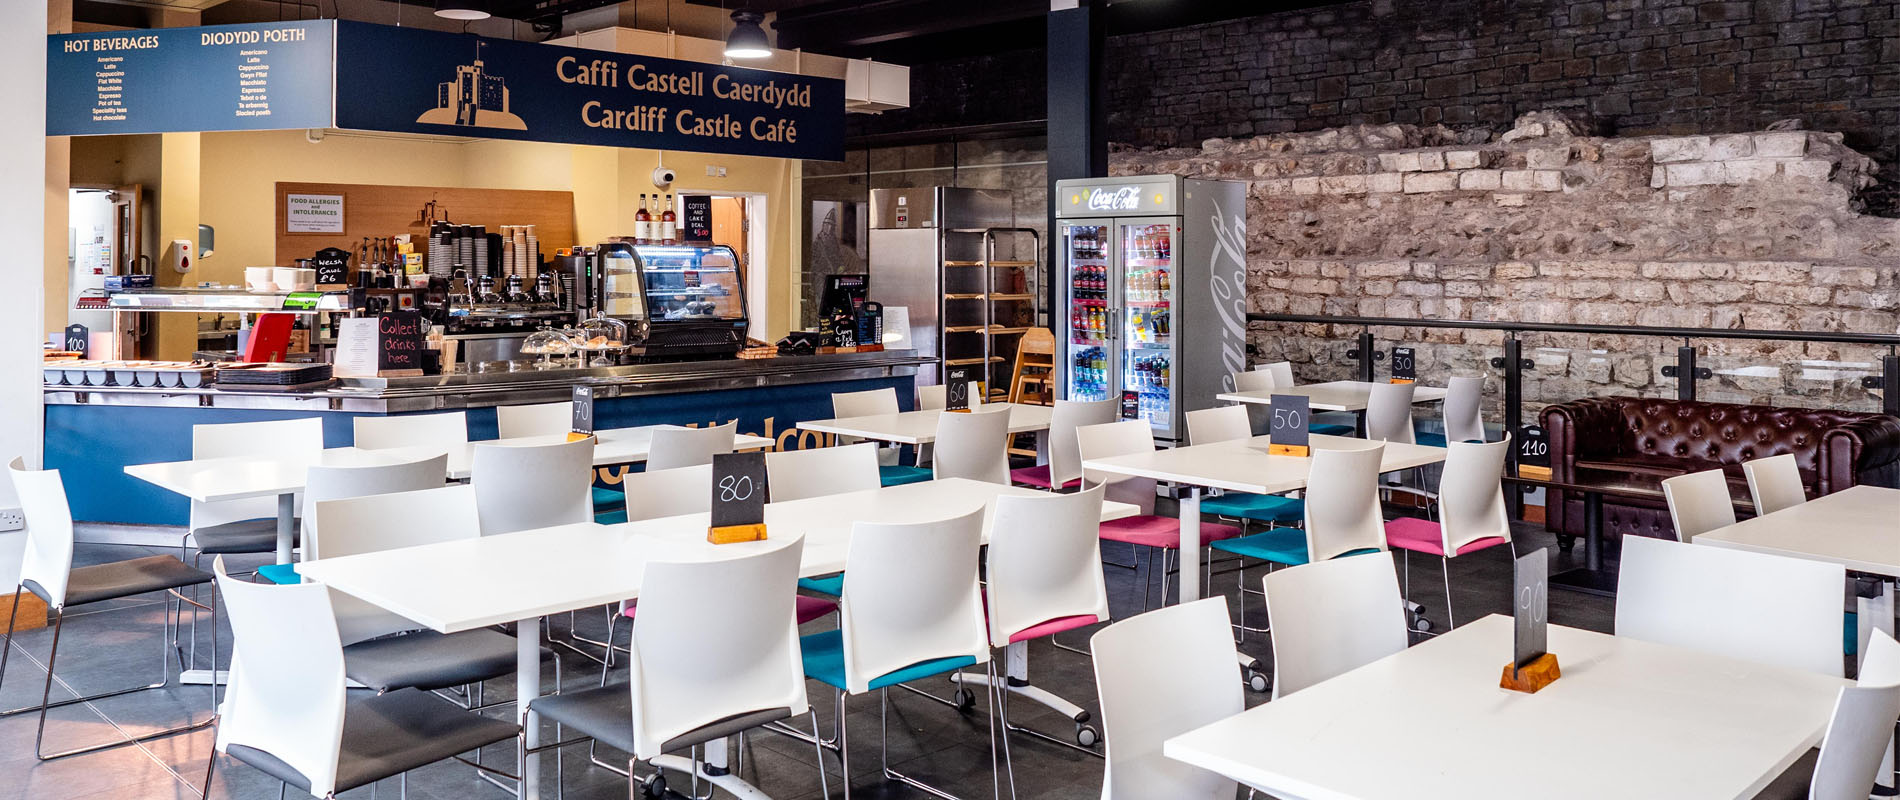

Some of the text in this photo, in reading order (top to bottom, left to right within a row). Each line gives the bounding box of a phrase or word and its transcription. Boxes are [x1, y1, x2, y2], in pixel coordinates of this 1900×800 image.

[64, 36, 159, 53] HOT BEVERAGES
[201, 28, 305, 46] DIODYDD POETH
[556, 56, 811, 109] Caffi Castell Caerdydd
[581, 100, 797, 143] Cardiff Castle Café
[1088, 186, 1142, 210] Coca-Cola
[380, 316, 418, 335] Collect
[67, 336, 85, 351] 100
[385, 337, 416, 351] drinks
[387, 352, 410, 363] here
[1394, 356, 1412, 370] 30
[950, 382, 966, 402] 60
[574, 400, 589, 420] 70
[1273, 408, 1301, 430] 50
[1521, 440, 1547, 456] 110
[719, 475, 753, 502] 80
[1520, 581, 1544, 629] 90
